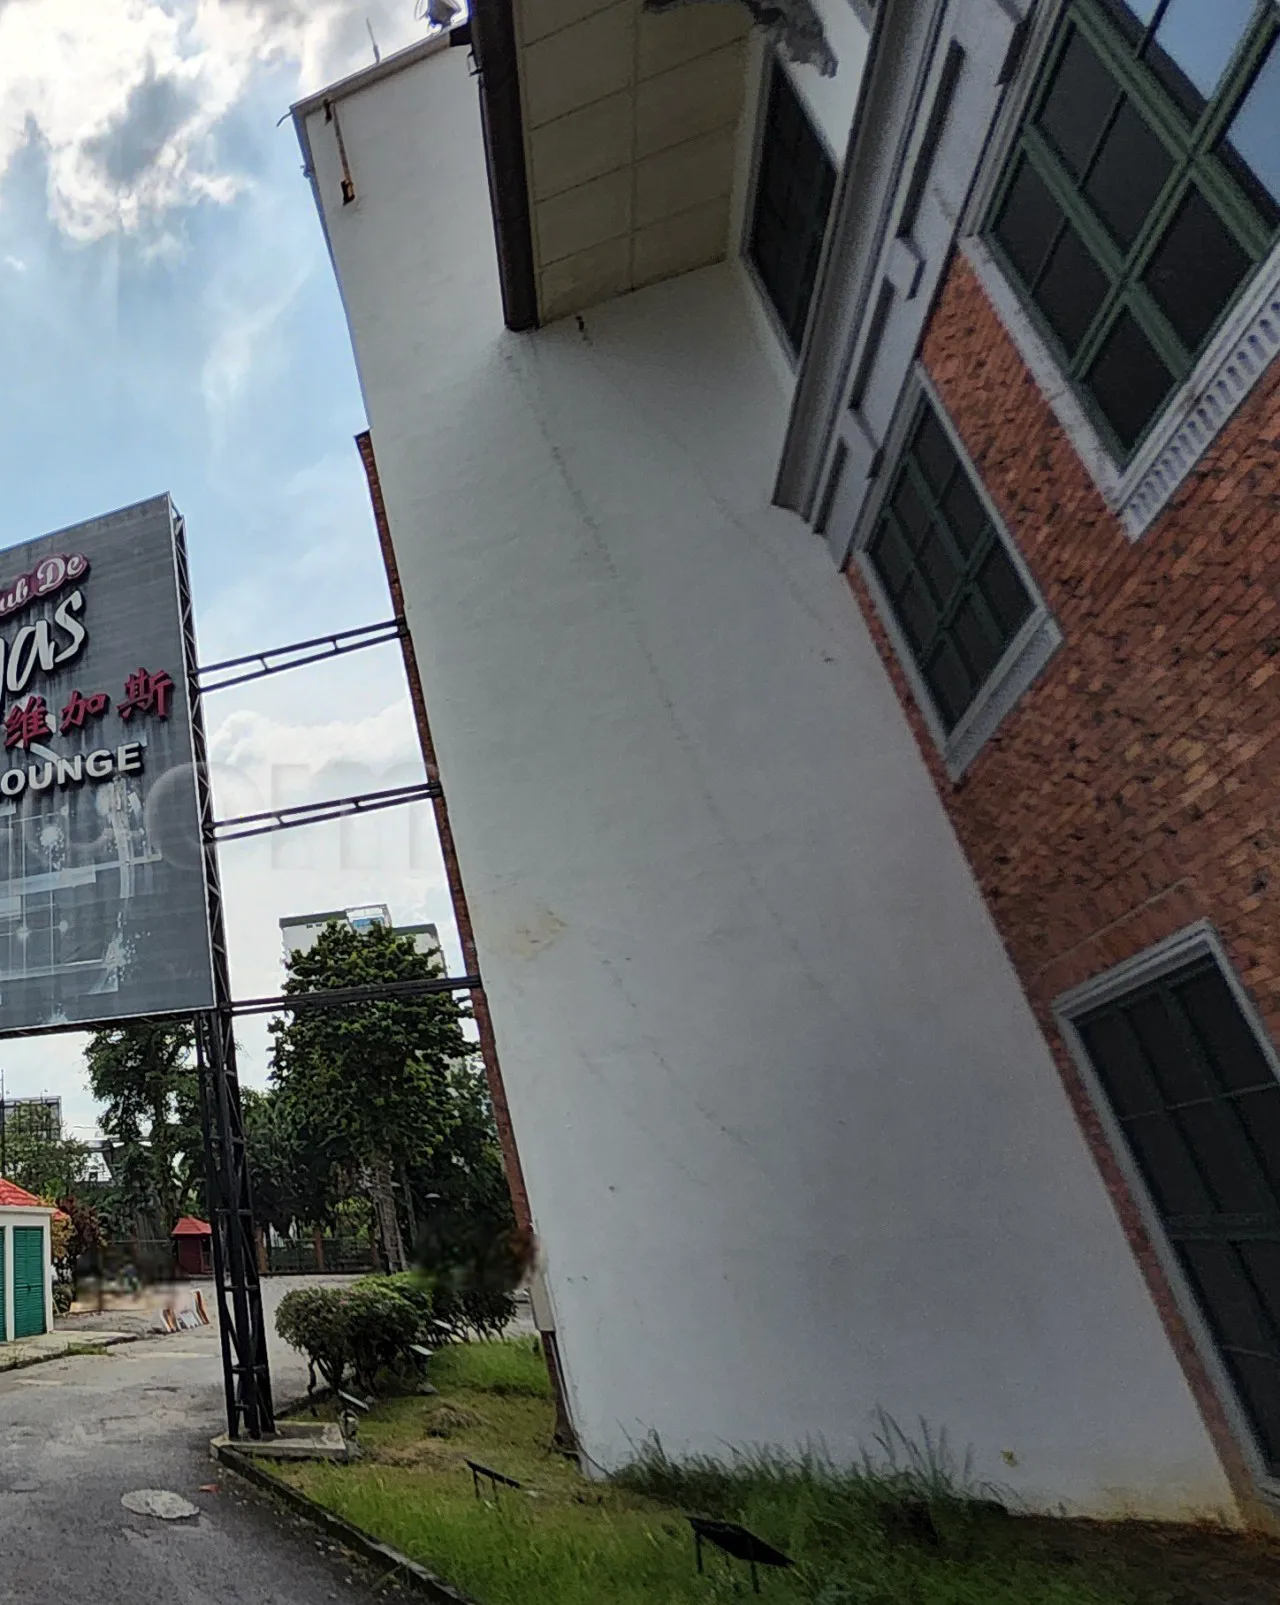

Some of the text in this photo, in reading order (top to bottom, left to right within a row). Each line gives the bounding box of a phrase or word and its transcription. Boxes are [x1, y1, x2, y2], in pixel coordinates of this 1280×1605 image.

[34, 553, 87, 592] De
[4, 667, 173, 749] 维加斯
